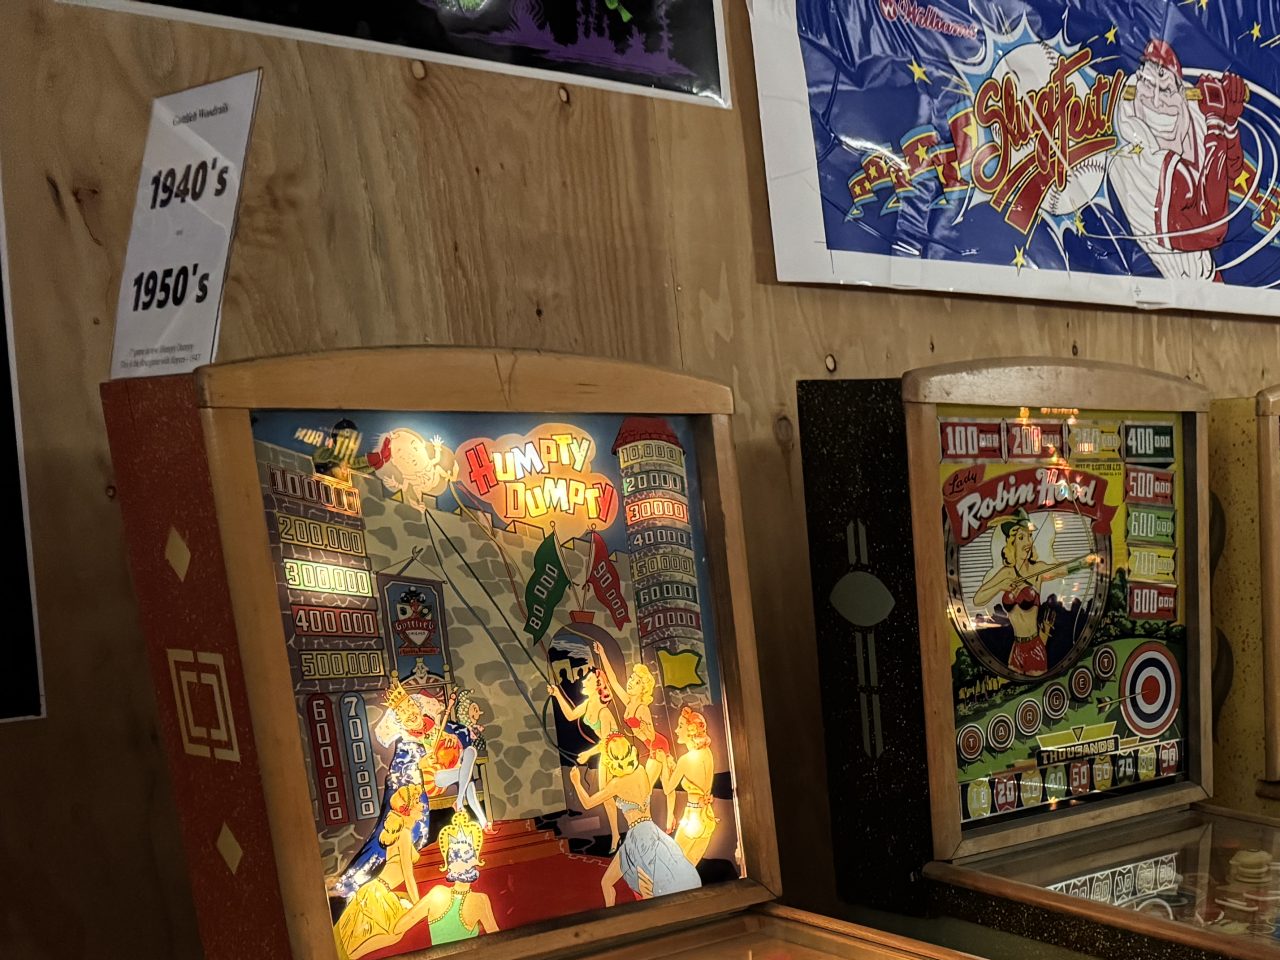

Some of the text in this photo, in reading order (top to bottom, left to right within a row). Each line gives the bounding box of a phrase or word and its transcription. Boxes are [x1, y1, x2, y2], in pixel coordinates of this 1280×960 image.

[905, 3, 978, 39] Williams
[150, 157, 229, 210] 1940's
[132, 262, 209, 312] 1950's
[466, 434, 591, 496] HUMPTY
[948, 471, 978, 496] Lady
[504, 477, 614, 523] DUMPTY
[956, 468, 1097, 539] Robin Hood
[1041, 738, 1117, 765] THOUSANDS
